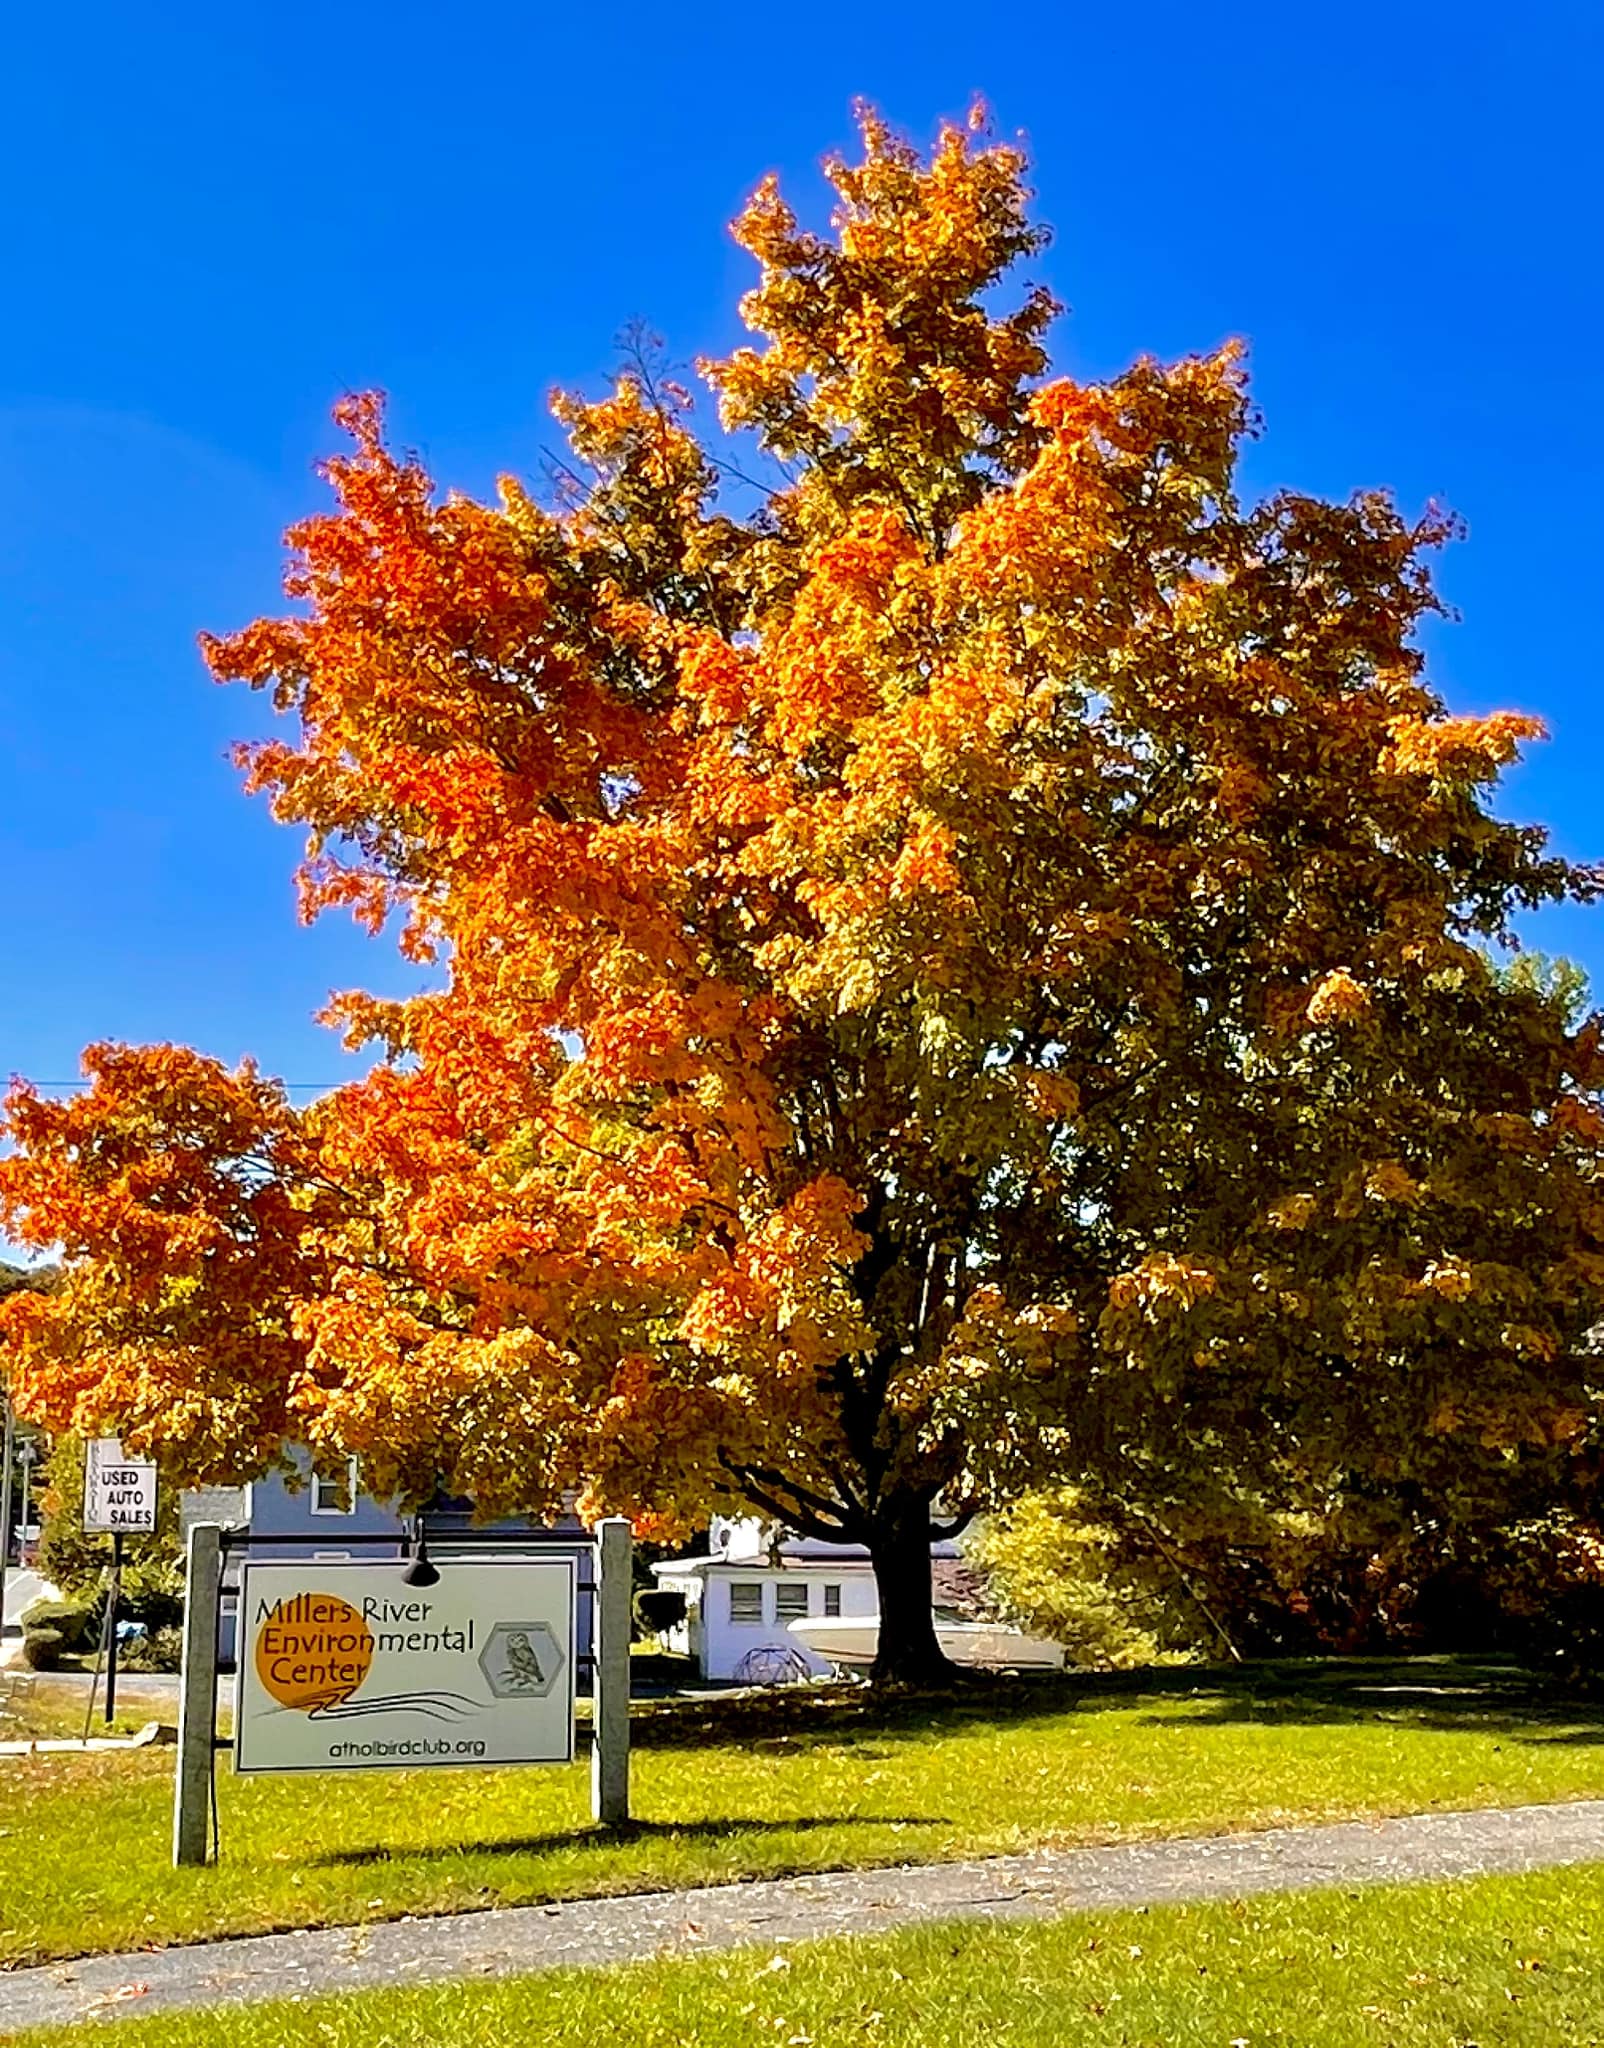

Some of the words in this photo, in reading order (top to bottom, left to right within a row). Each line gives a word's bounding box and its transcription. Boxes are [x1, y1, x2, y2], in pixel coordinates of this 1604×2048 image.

[102, 1471, 139, 1486] USED
[107, 1491, 144, 1505] AUTO
[110, 1510, 152, 1524] SALES
[255, 1592, 353, 1625] Millers
[362, 1596, 433, 1623] River
[263, 1619, 474, 1655] Environmental
[270, 1657, 368, 1685] Center
[328, 1738, 486, 1758] atholbirdclub.org
